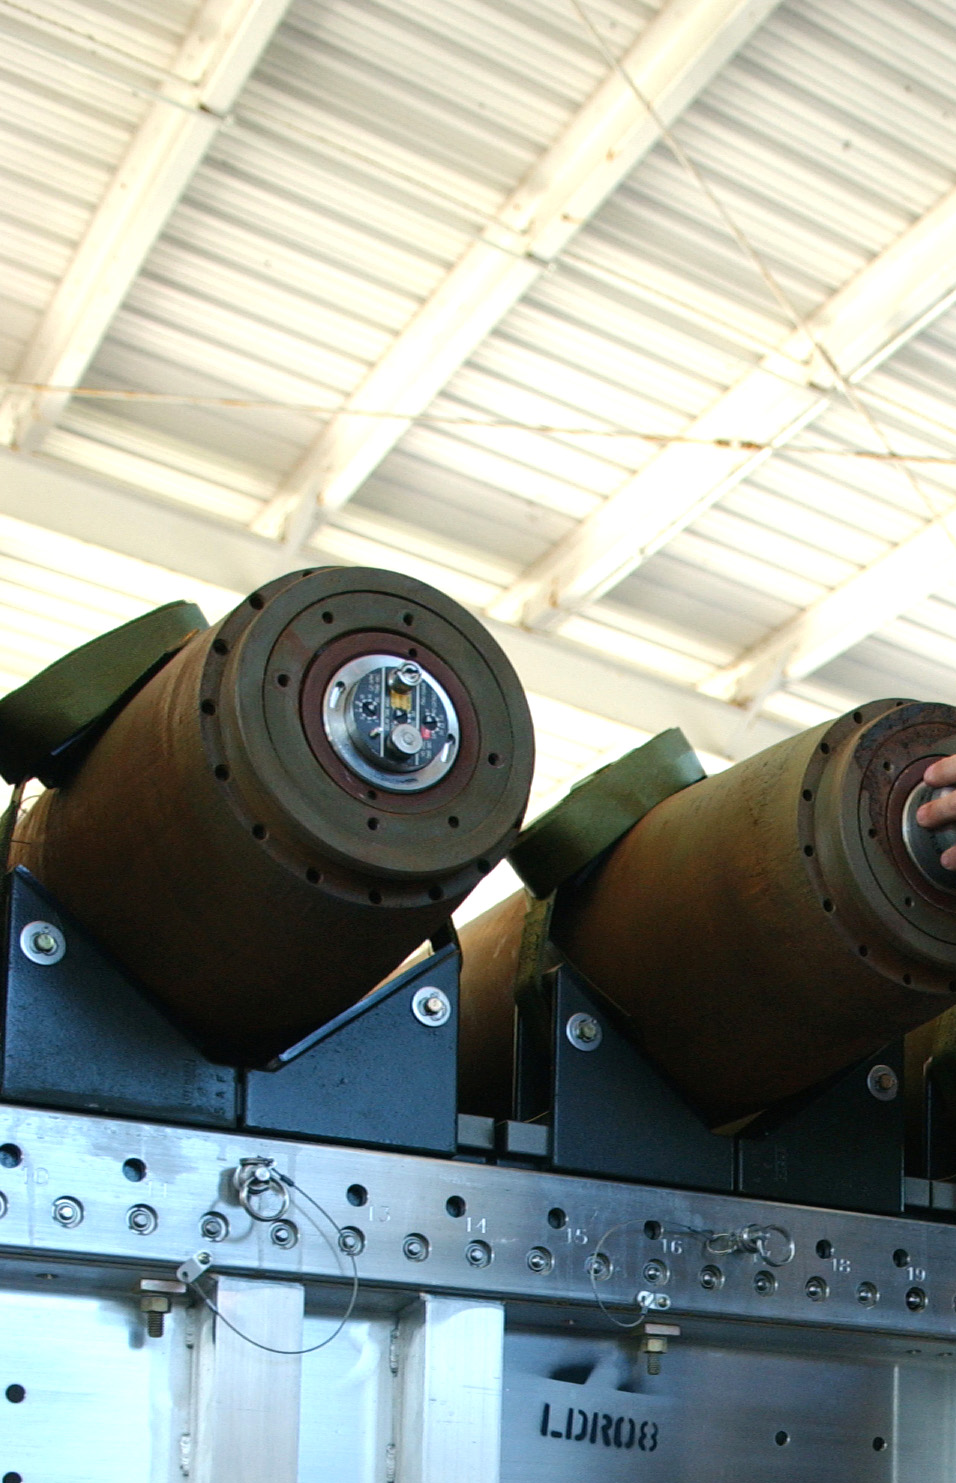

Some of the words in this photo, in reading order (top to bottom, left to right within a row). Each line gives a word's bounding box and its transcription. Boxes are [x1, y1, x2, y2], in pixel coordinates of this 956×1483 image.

[368, 1206, 391, 1223] 13
[466, 1217, 487, 1234] 14
[565, 1227, 589, 1245] 15
[661, 1238, 683, 1255] 16
[831, 1258, 851, 1274] 18
[906, 1266, 926, 1282] 19
